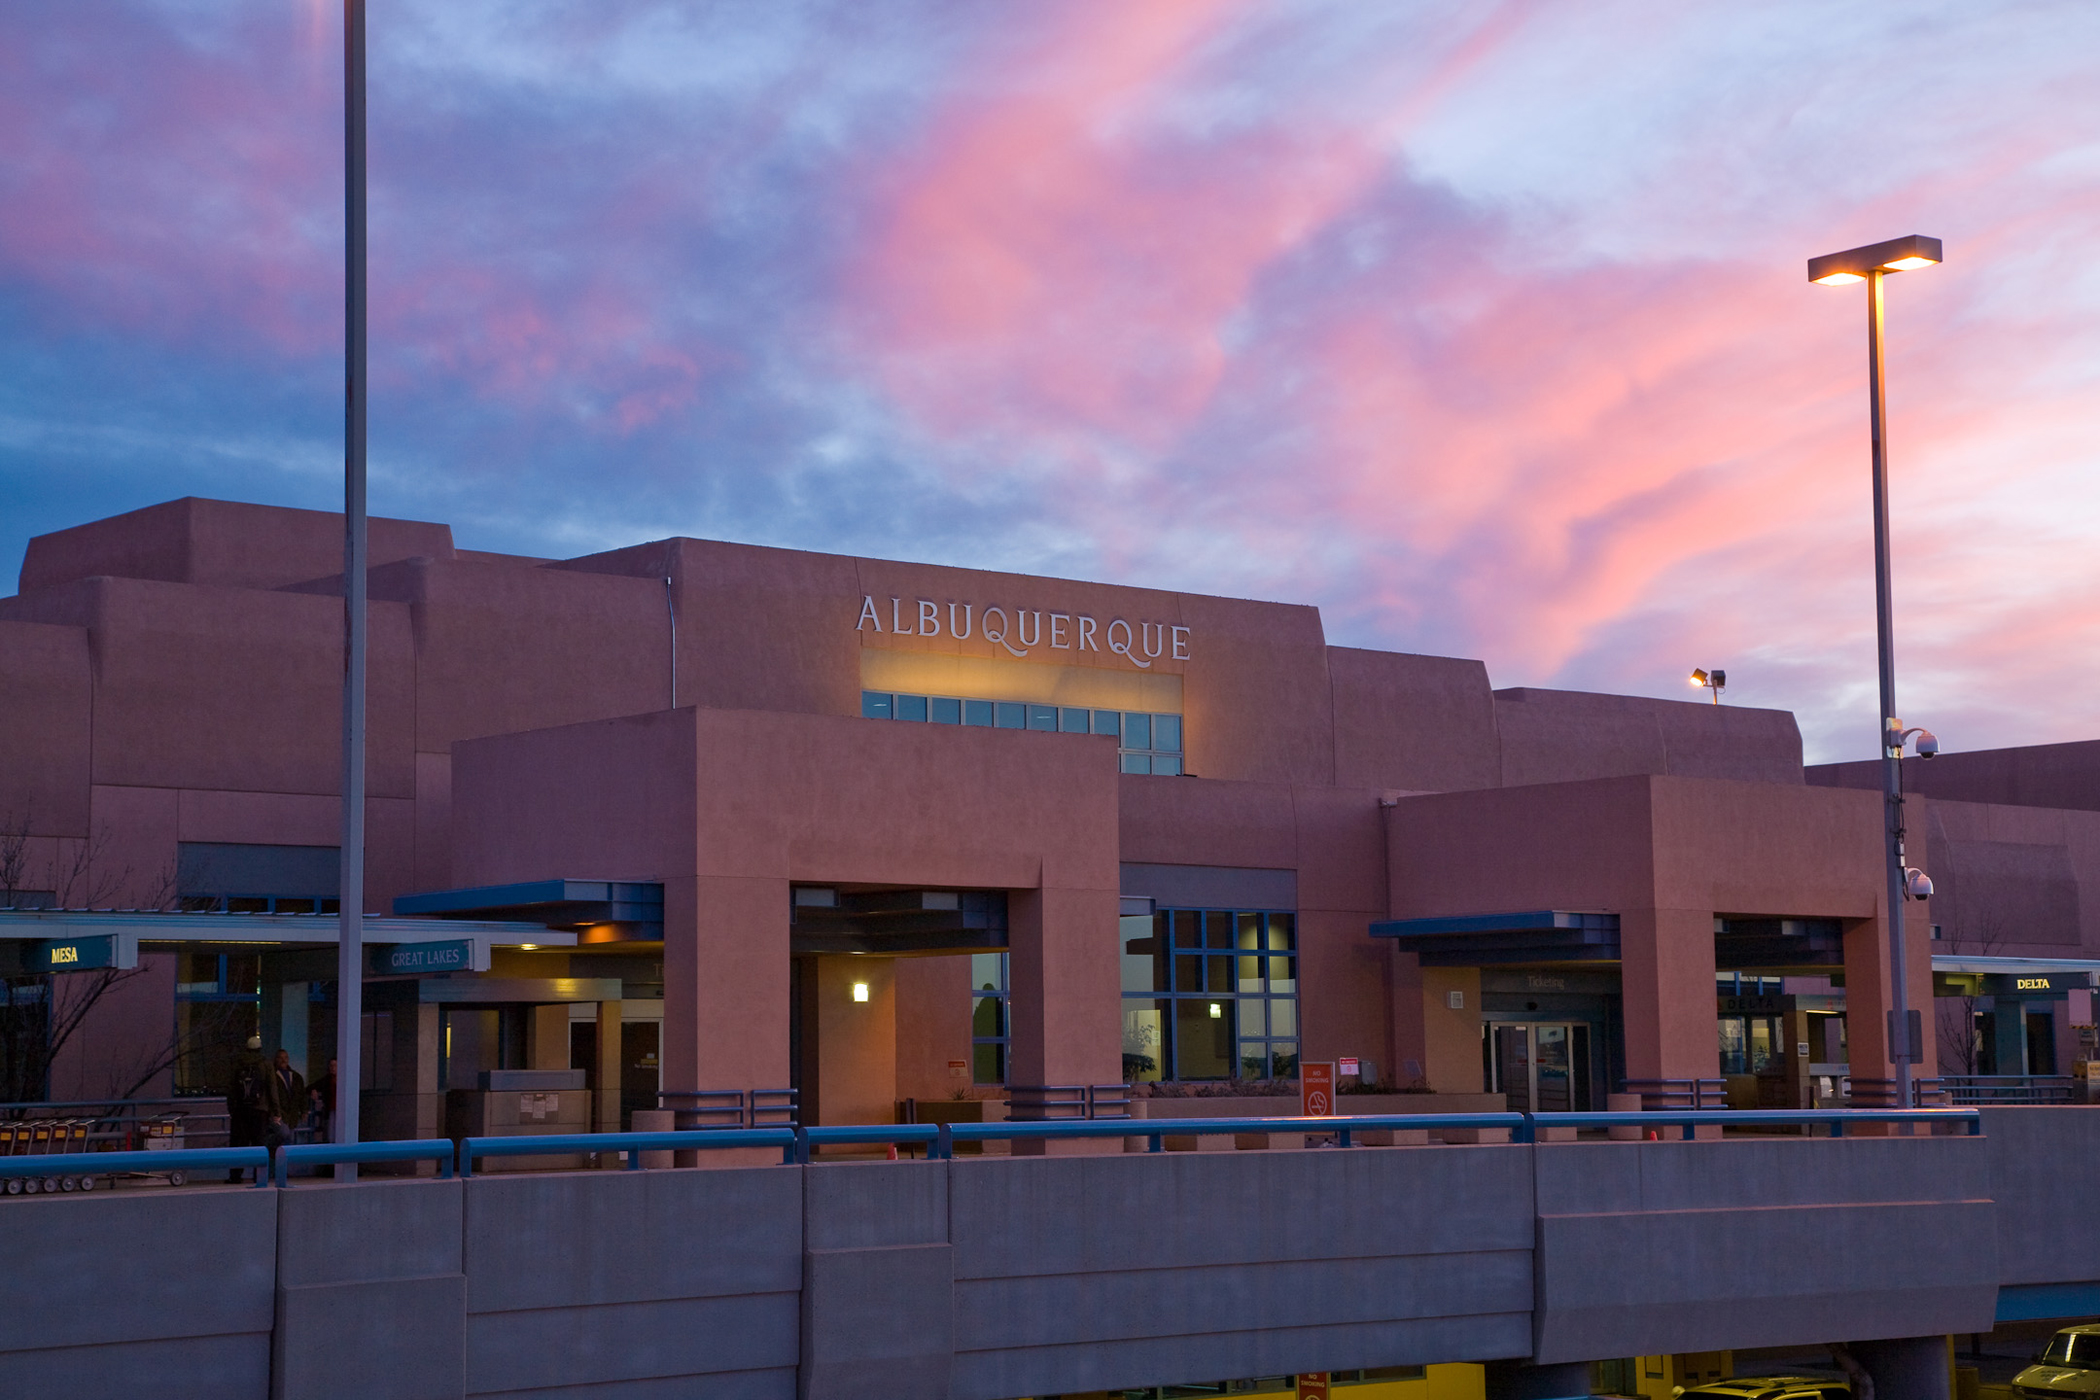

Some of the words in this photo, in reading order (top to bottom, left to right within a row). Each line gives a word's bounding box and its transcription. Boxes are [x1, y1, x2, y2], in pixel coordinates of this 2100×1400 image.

[855, 595, 1191, 668] ALBUQUERQUE
[51, 947, 78, 964] MESA
[391, 951, 424, 967] GREAT
[427, 949, 459, 965] LAKES
[1527, 976, 1565, 990] Ticketing
[2017, 979, 2050, 990] DELTA
[1728, 998, 1774, 1010] DELTA
[1300, 1380, 1325, 1388] SMOKING
